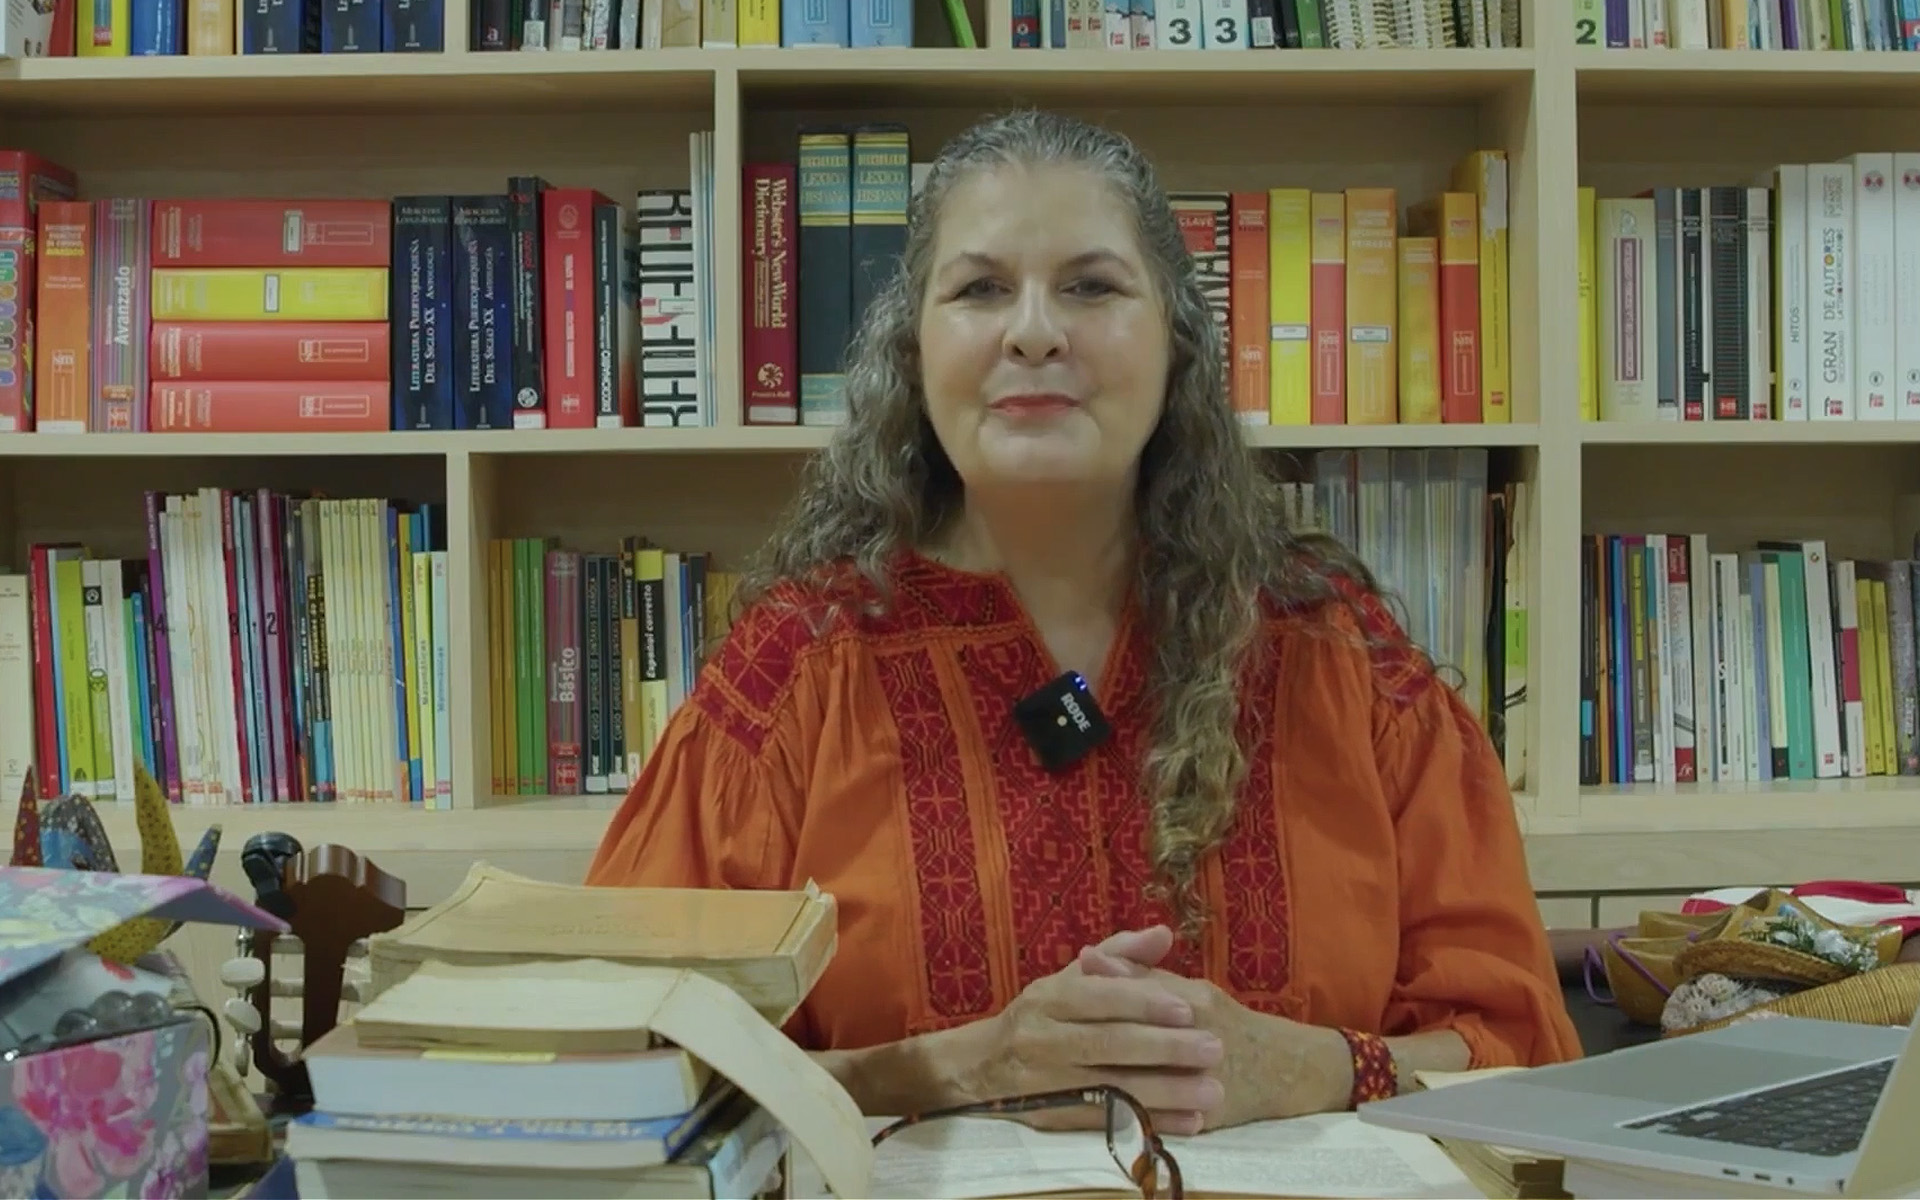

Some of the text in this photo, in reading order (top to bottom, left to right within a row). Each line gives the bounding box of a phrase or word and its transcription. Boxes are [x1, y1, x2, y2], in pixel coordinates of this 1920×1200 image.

[1169, 18, 1193, 45] 3
[1215, 17, 1238, 44] 3
[1575, 19, 1597, 46] 2
[752, 178, 771, 259] Dictionary
[1178, 216, 1214, 228] CLAVE
[770, 178, 788, 328] Webster's New World
[113, 266, 131, 345] Avanzado
[409, 239, 421, 391] LITERATURA PUERTORRIQUEÑA
[424, 307, 436, 325] XX
[483, 307, 495, 326] XX
[1823, 228, 1837, 384] GRAN DE AUTORES
[1789, 306, 1799, 344] HITOS
[424, 326, 435, 360] SIGLO
[483, 327, 495, 360] SIGLO
[424, 361, 435, 384] DEL
[468, 332, 480, 392] LITERATURA
[484, 362, 496, 384] DEL
[265, 611, 277, 635] 2
[644, 584, 657, 678] Español correcto
[558, 648, 575, 703] Básico
[590, 658, 600, 670] DE
[590, 713, 600, 741] CURSO
